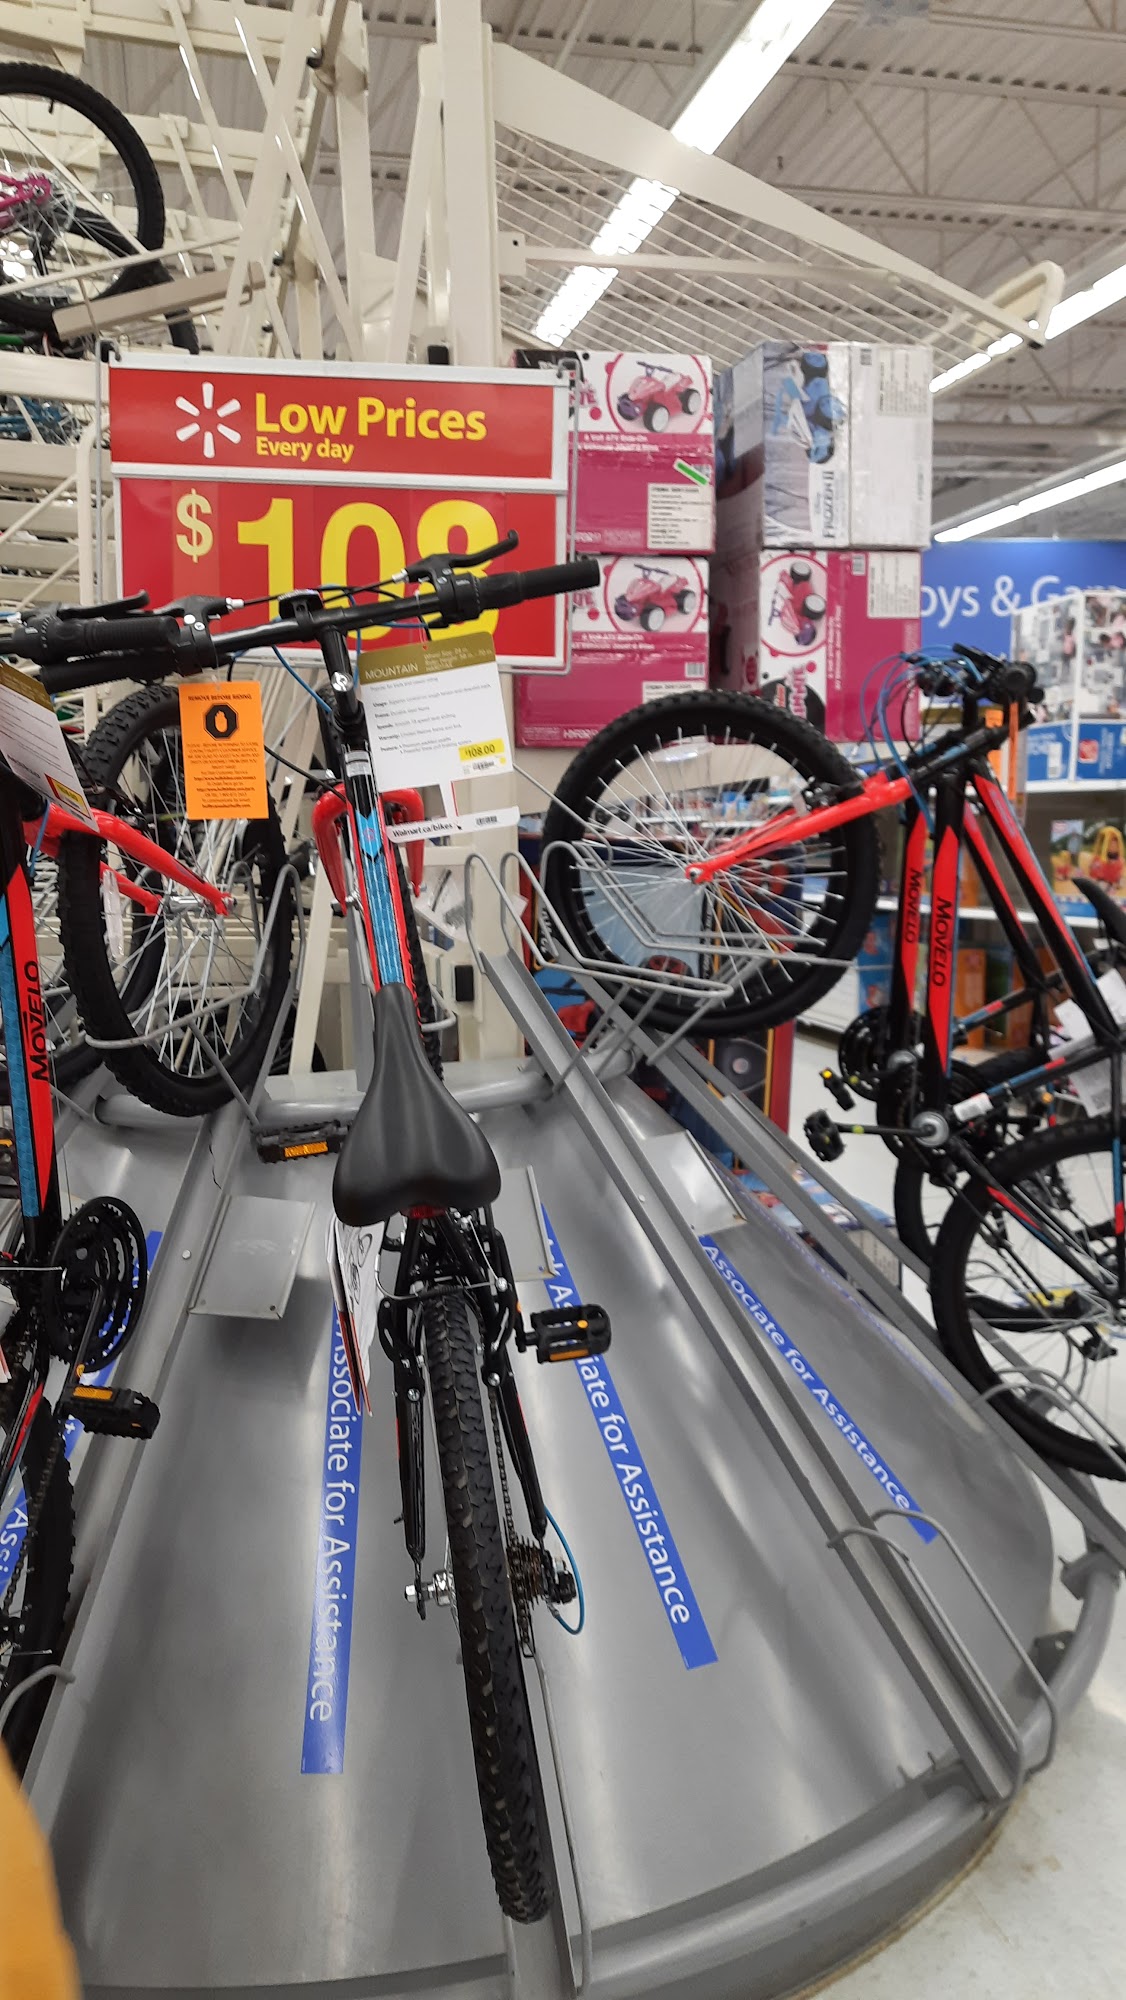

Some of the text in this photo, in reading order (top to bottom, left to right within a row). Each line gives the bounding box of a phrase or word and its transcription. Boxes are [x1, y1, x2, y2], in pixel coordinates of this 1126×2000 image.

[256, 393, 487, 440] Low Prices
[256, 436, 354, 464] Every day
[176, 488, 499, 641] $ 108
[991, 575, 1020, 617] &
[365, 663, 420, 680] MOUNTAIN
[393, 823, 453, 837] Walmart.ca/bikes
[905, 869, 922, 943] MOVELO
[932, 896, 952, 986] MOVELO
[23, 961, 49, 1081] MOVELO
[703, 1245, 785, 1346] Associate
[784, 1348, 814, 1382] for
[812, 1388, 910, 1510] Assistance
[549, 1284, 690, 1624] Aiate for Assistance
[325, 1480, 355, 1526] for
[309, 1535, 351, 1722] Assistance
